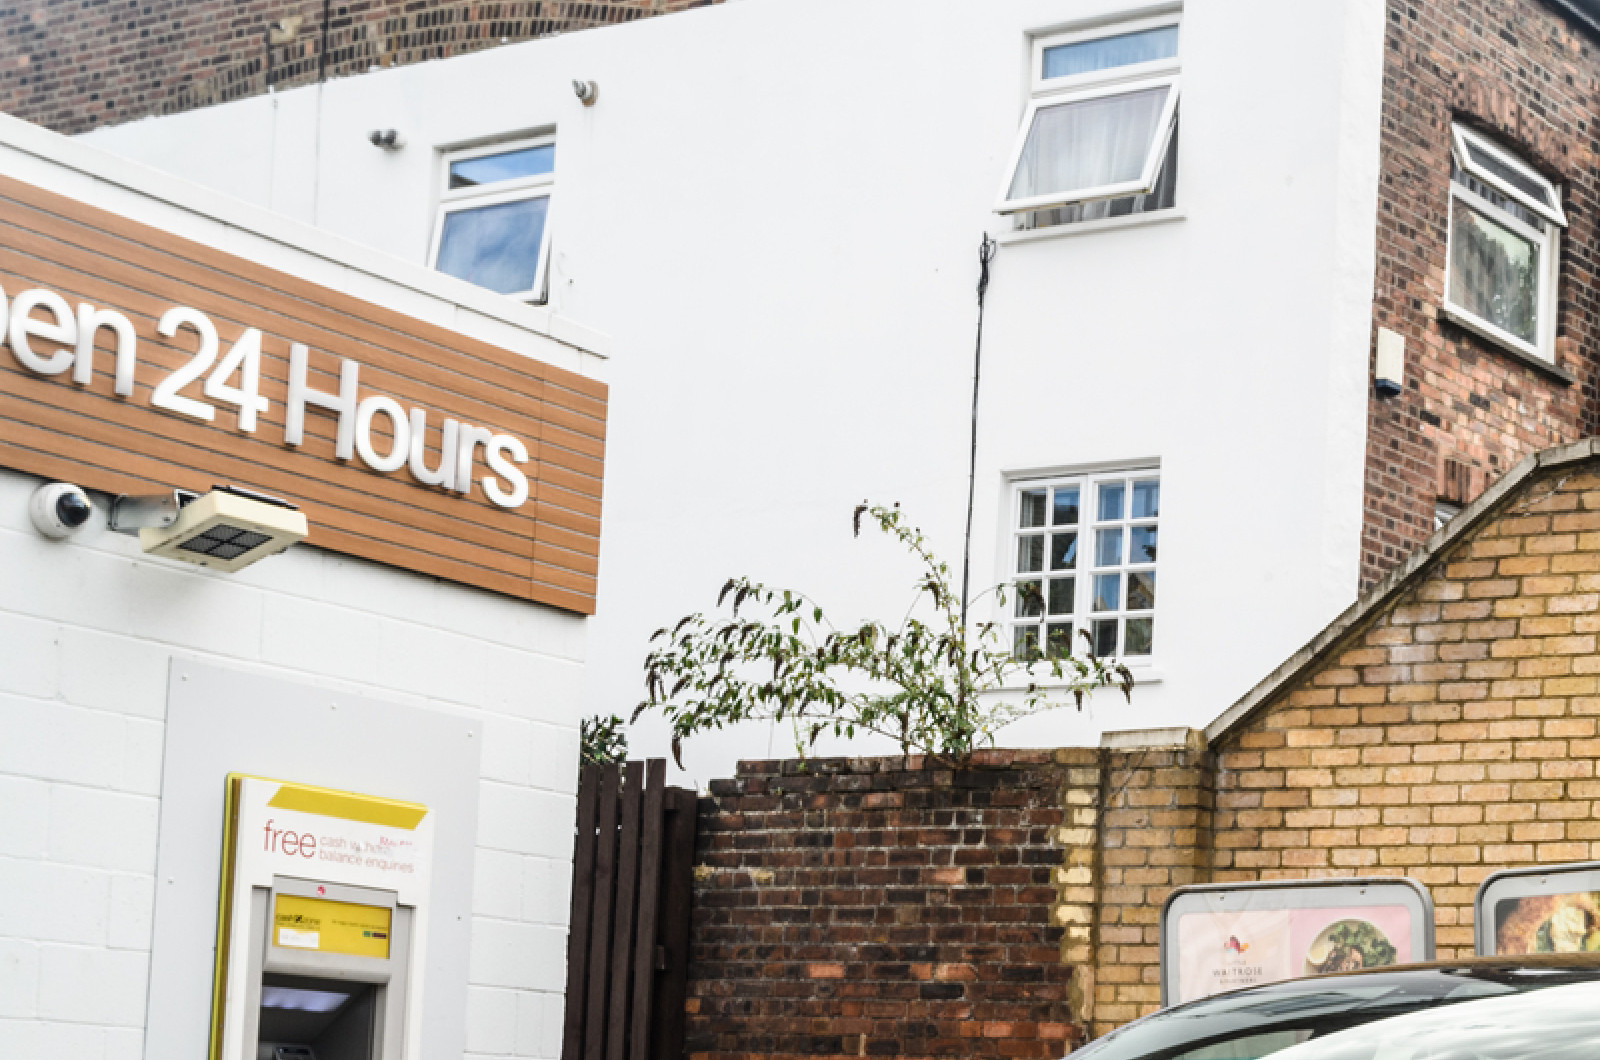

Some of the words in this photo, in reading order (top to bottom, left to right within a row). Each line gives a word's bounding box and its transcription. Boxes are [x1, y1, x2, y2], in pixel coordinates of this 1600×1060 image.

[0, 281, 136, 397] en
[151, 306, 269, 433] 24
[284, 342, 529, 509] Hours
[263, 818, 317, 859] free
